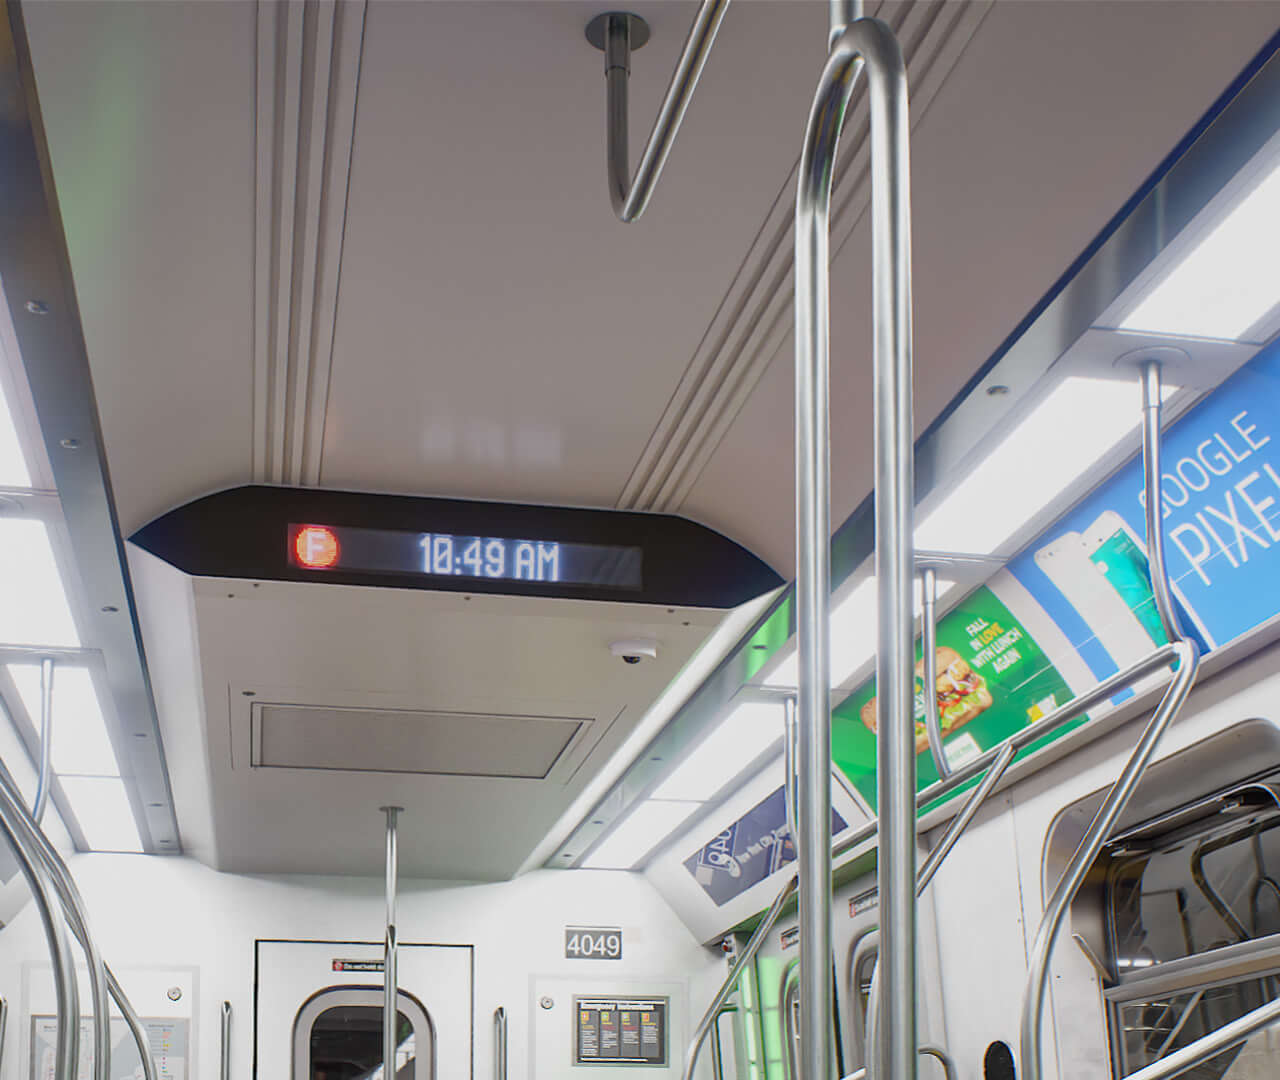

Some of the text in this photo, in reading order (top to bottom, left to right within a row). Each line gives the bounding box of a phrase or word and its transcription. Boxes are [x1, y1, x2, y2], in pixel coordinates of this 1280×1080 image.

[305, 531, 560, 582] F 10:49 AM
[978, 622, 1005, 645] LOVE
[567, 934, 620, 956] 4049
